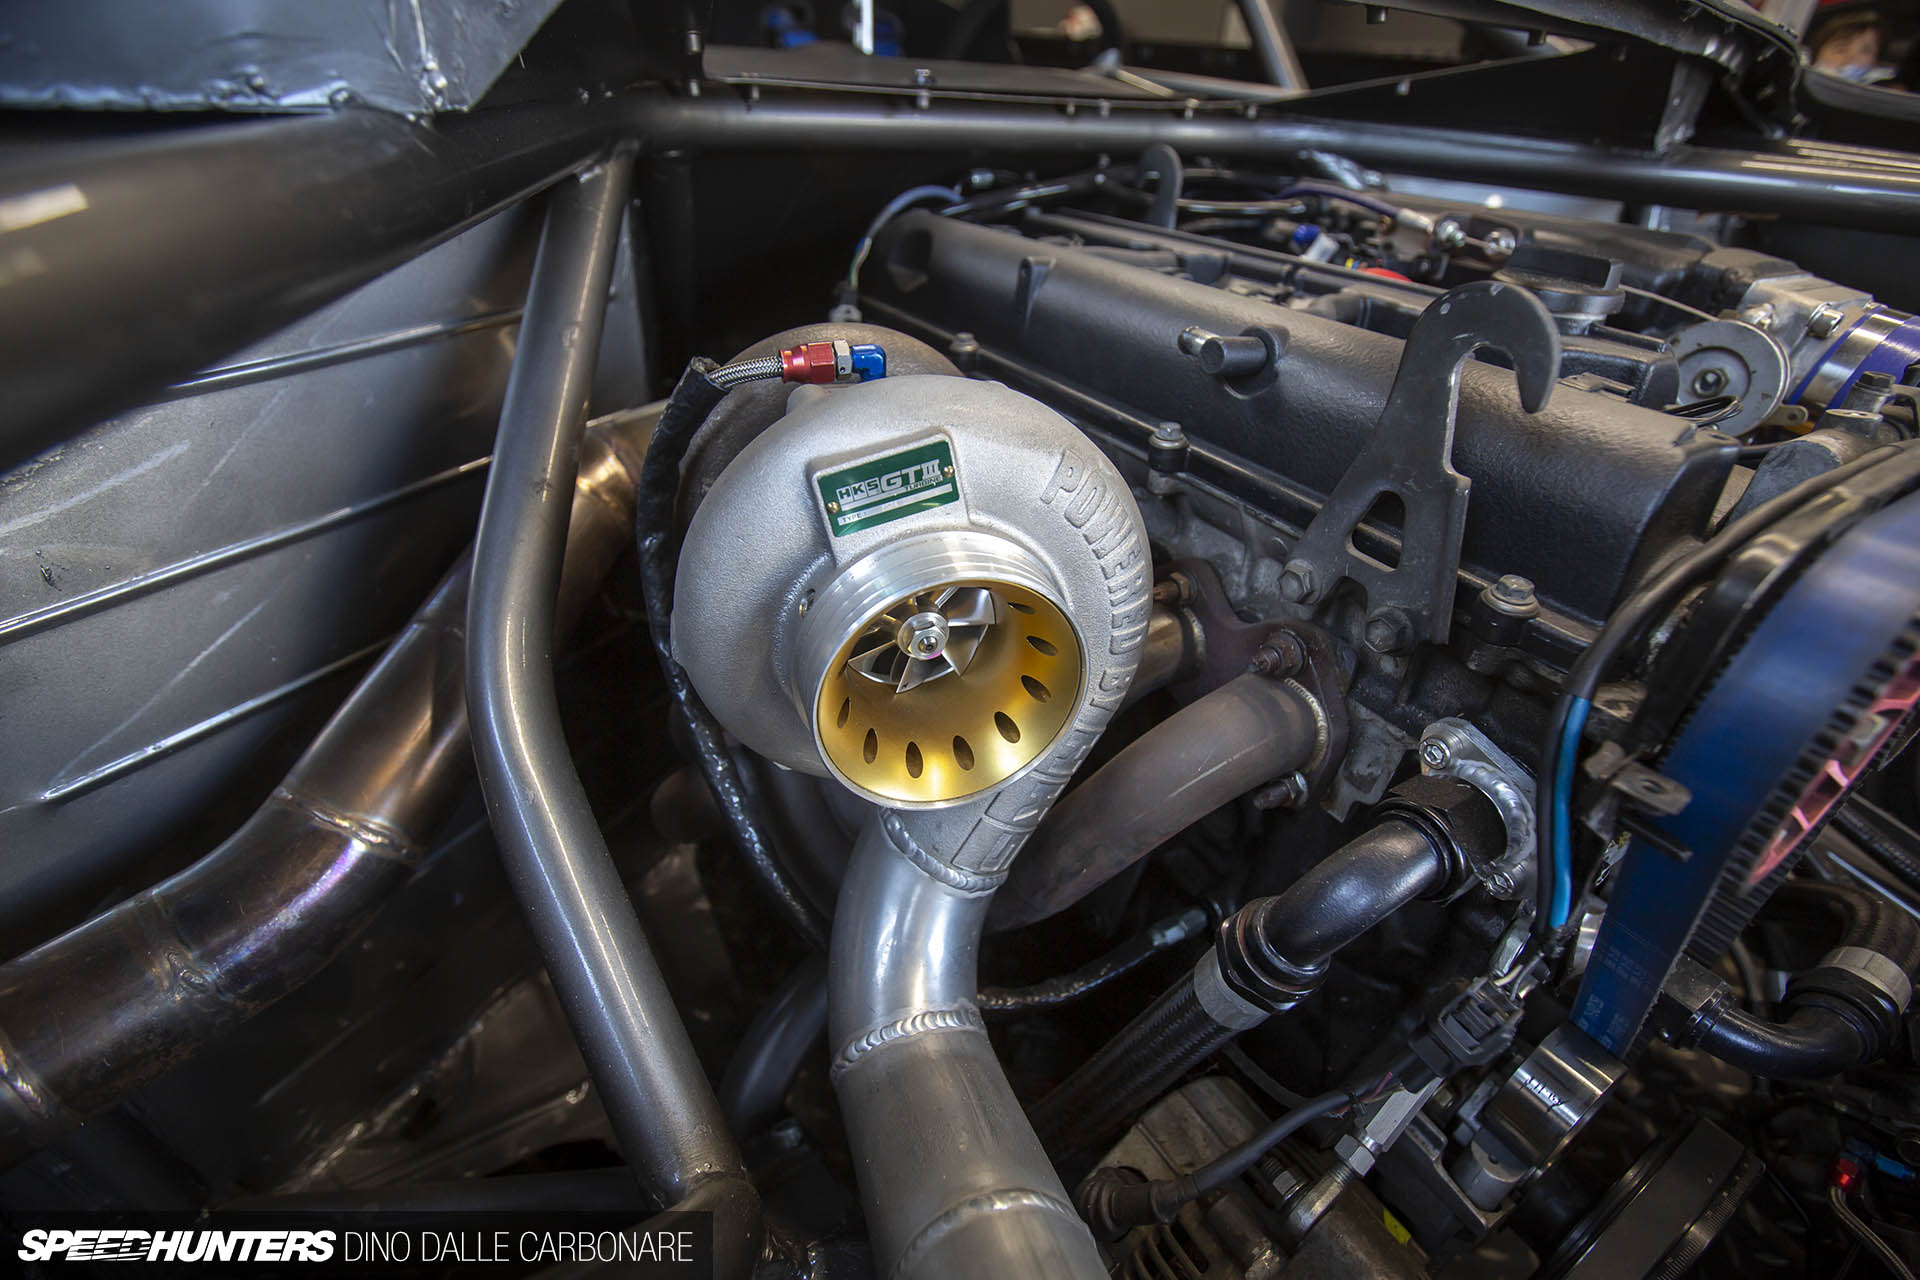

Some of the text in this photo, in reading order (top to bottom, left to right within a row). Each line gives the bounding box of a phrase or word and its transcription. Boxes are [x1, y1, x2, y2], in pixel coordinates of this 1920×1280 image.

[838, 478, 882, 502] HKS
[904, 476, 942, 490] TURBINE
[1039, 449, 1149, 655] POWERED
